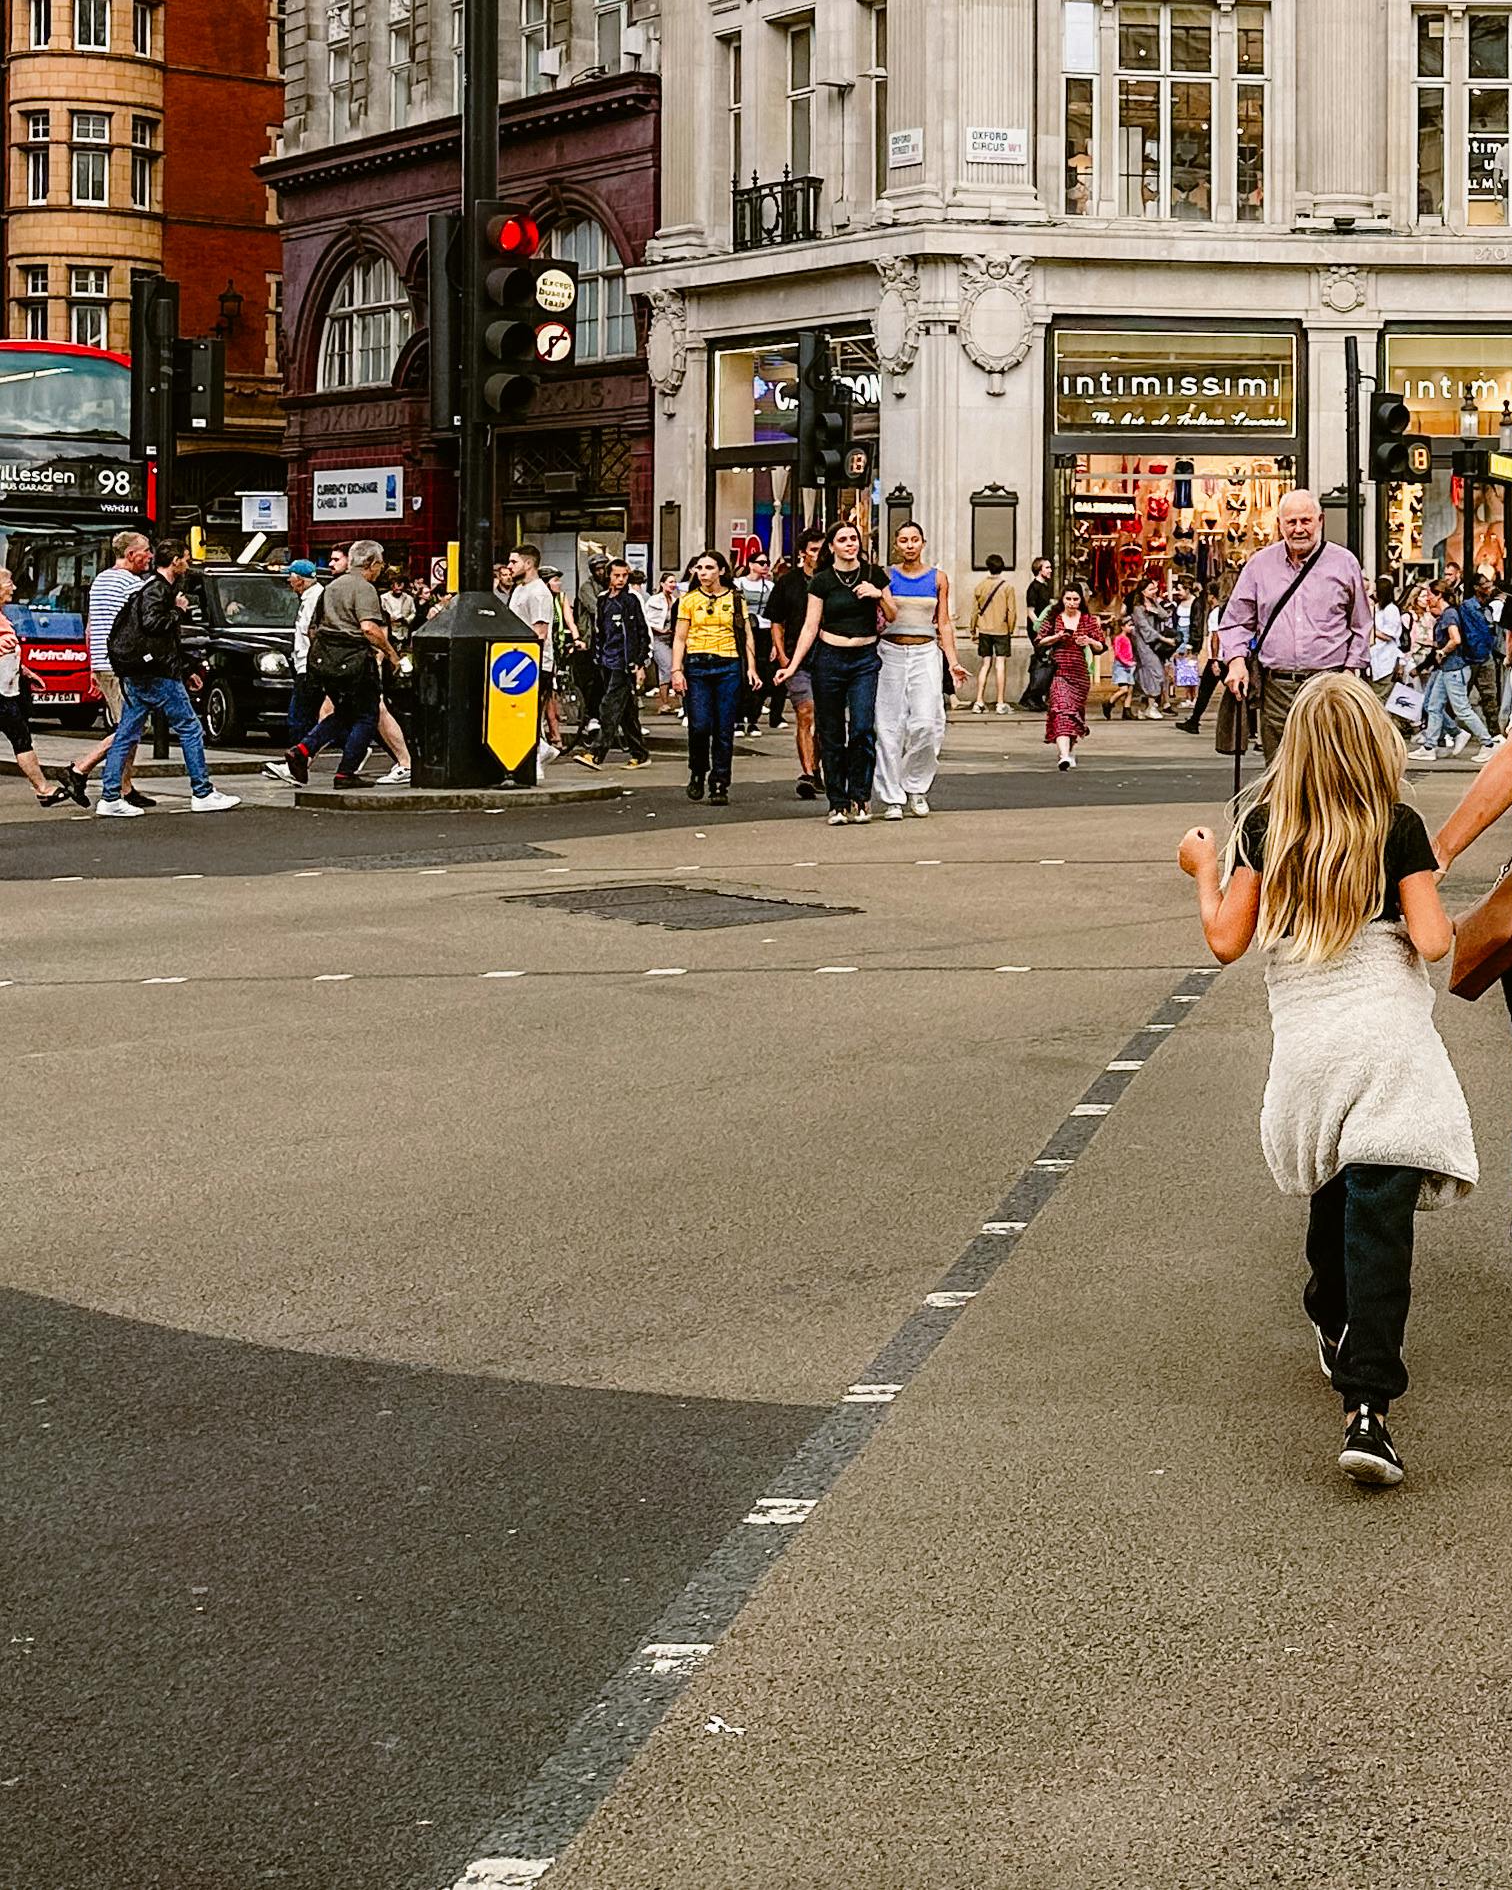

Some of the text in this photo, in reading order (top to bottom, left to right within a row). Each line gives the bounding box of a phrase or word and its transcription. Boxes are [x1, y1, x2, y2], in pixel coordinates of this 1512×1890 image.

[972, 131, 1008, 141] OXFORD
[972, 142, 1022, 152] CIRCUS W1
[1062, 371, 1280, 397] intimissimi
[0, 464, 75, 484] illesden
[18, 482, 54, 493] GARAGE
[97, 469, 131, 496] 98
[27, 648, 88, 662] Metroline
